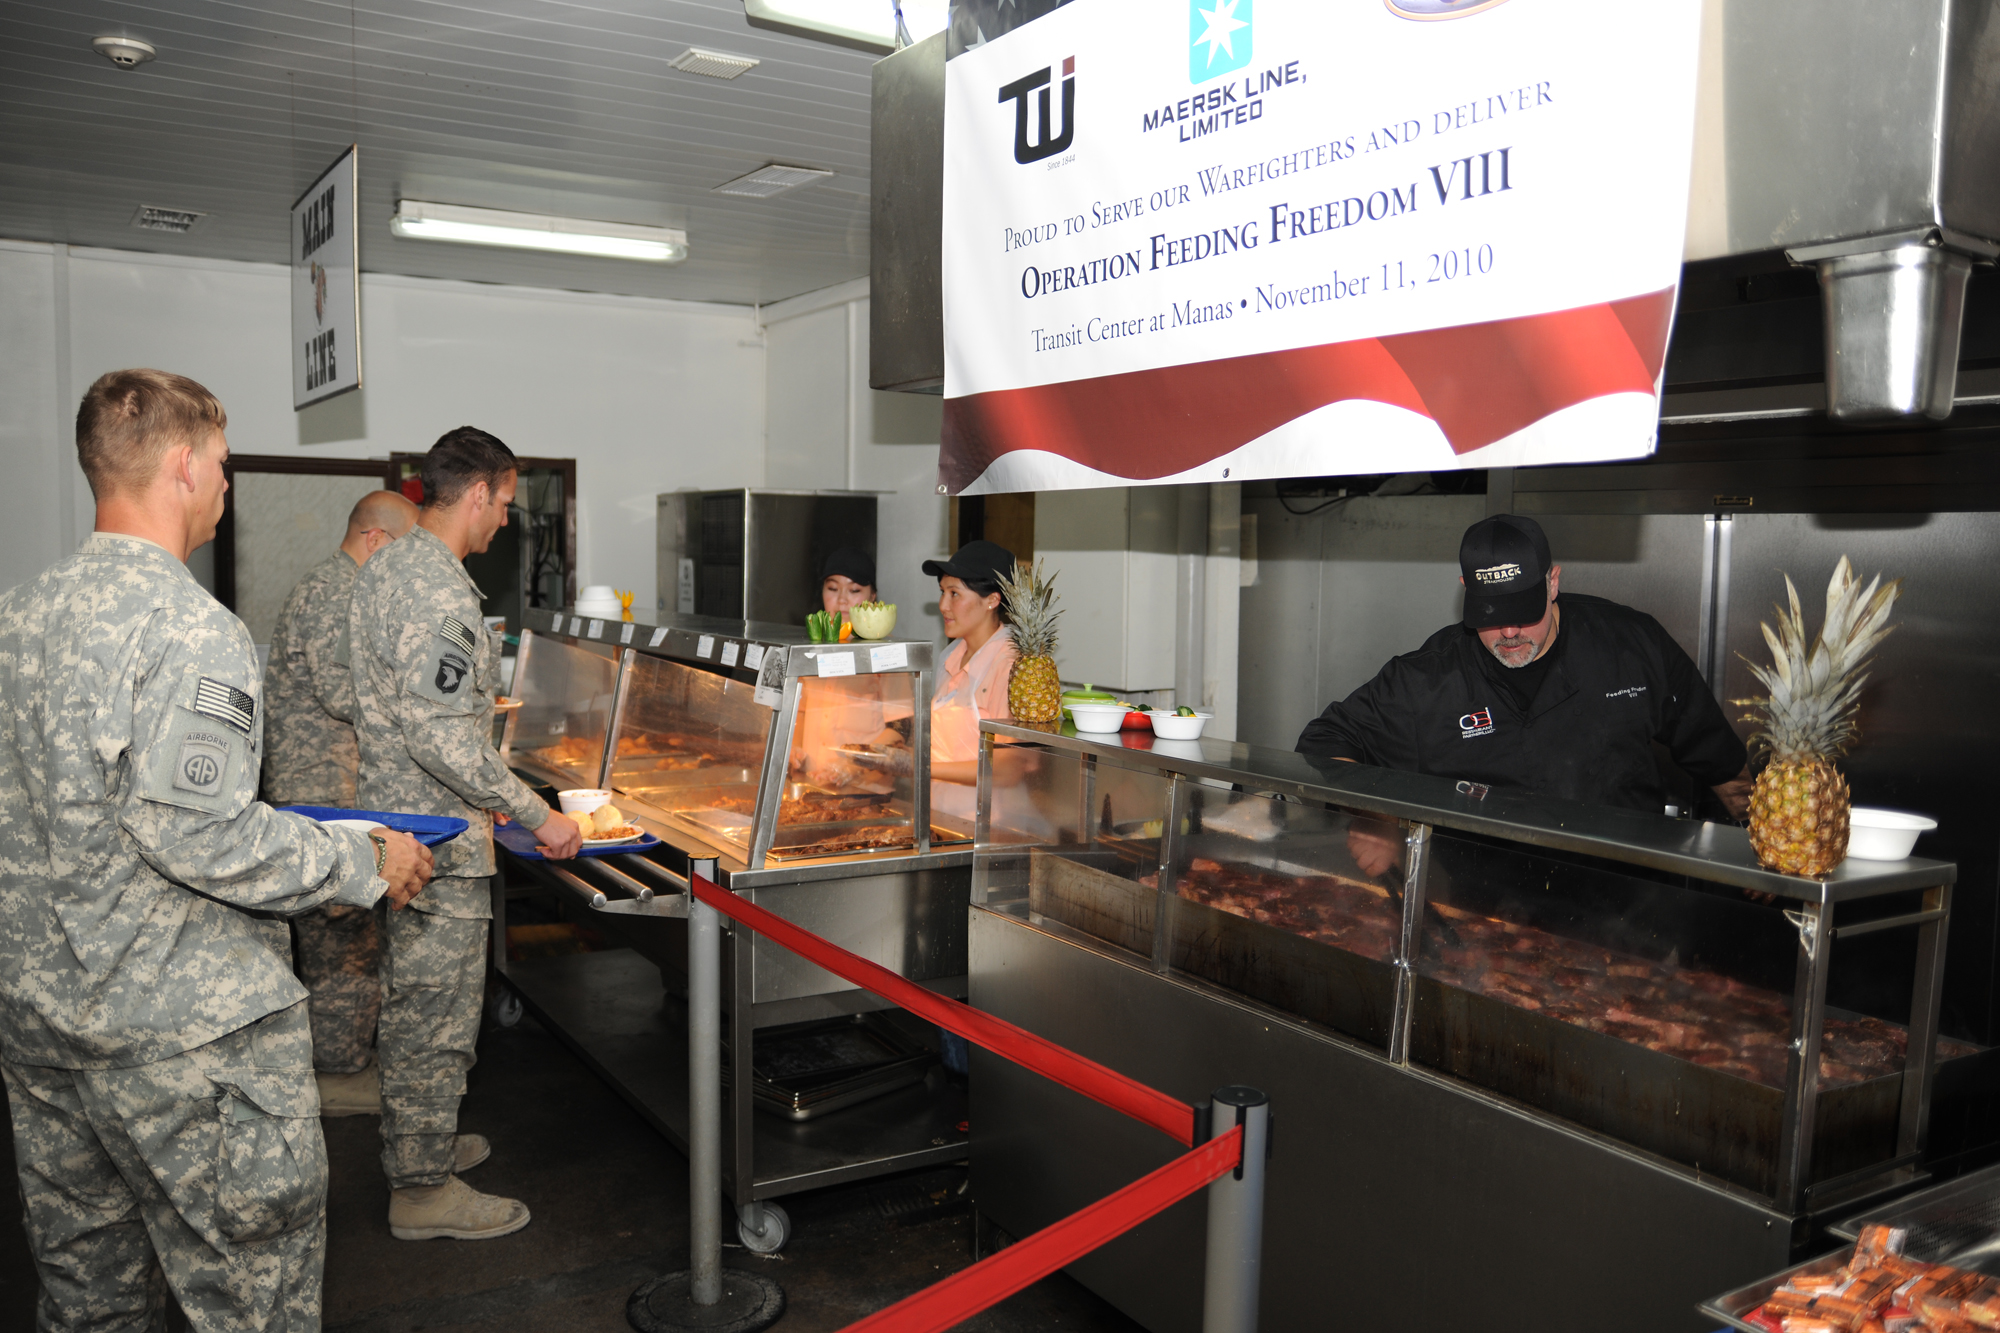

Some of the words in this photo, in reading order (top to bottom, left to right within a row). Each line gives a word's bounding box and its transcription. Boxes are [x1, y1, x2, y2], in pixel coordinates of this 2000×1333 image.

[1143, 82, 1237, 132] MAERSK
[1245, 60, 1307, 98] LINE,
[1179, 99, 1262, 143] LIMITED
[1047, 160, 1060, 172] Since
[1062, 154, 1077, 167] 1844
[1428, 146, 1513, 206] VIII
[302, 184, 335, 260] MAIN
[1031, 324, 1082, 352] Transit
[1087, 317, 1144, 342] Center
[1149, 312, 1165, 332] at
[1171, 299, 1233, 328] Manas
[1255, 270, 1370, 313] November
[1381, 260, 1416, 291] 11,
[1426, 243, 1493, 283] 2010
[305, 327, 336, 391] LINE
[1476, 567, 1522, 580] OUTBACK
[1606, 688, 1630, 698] Feeding
[186, 733, 227, 750] AIRBORNE
